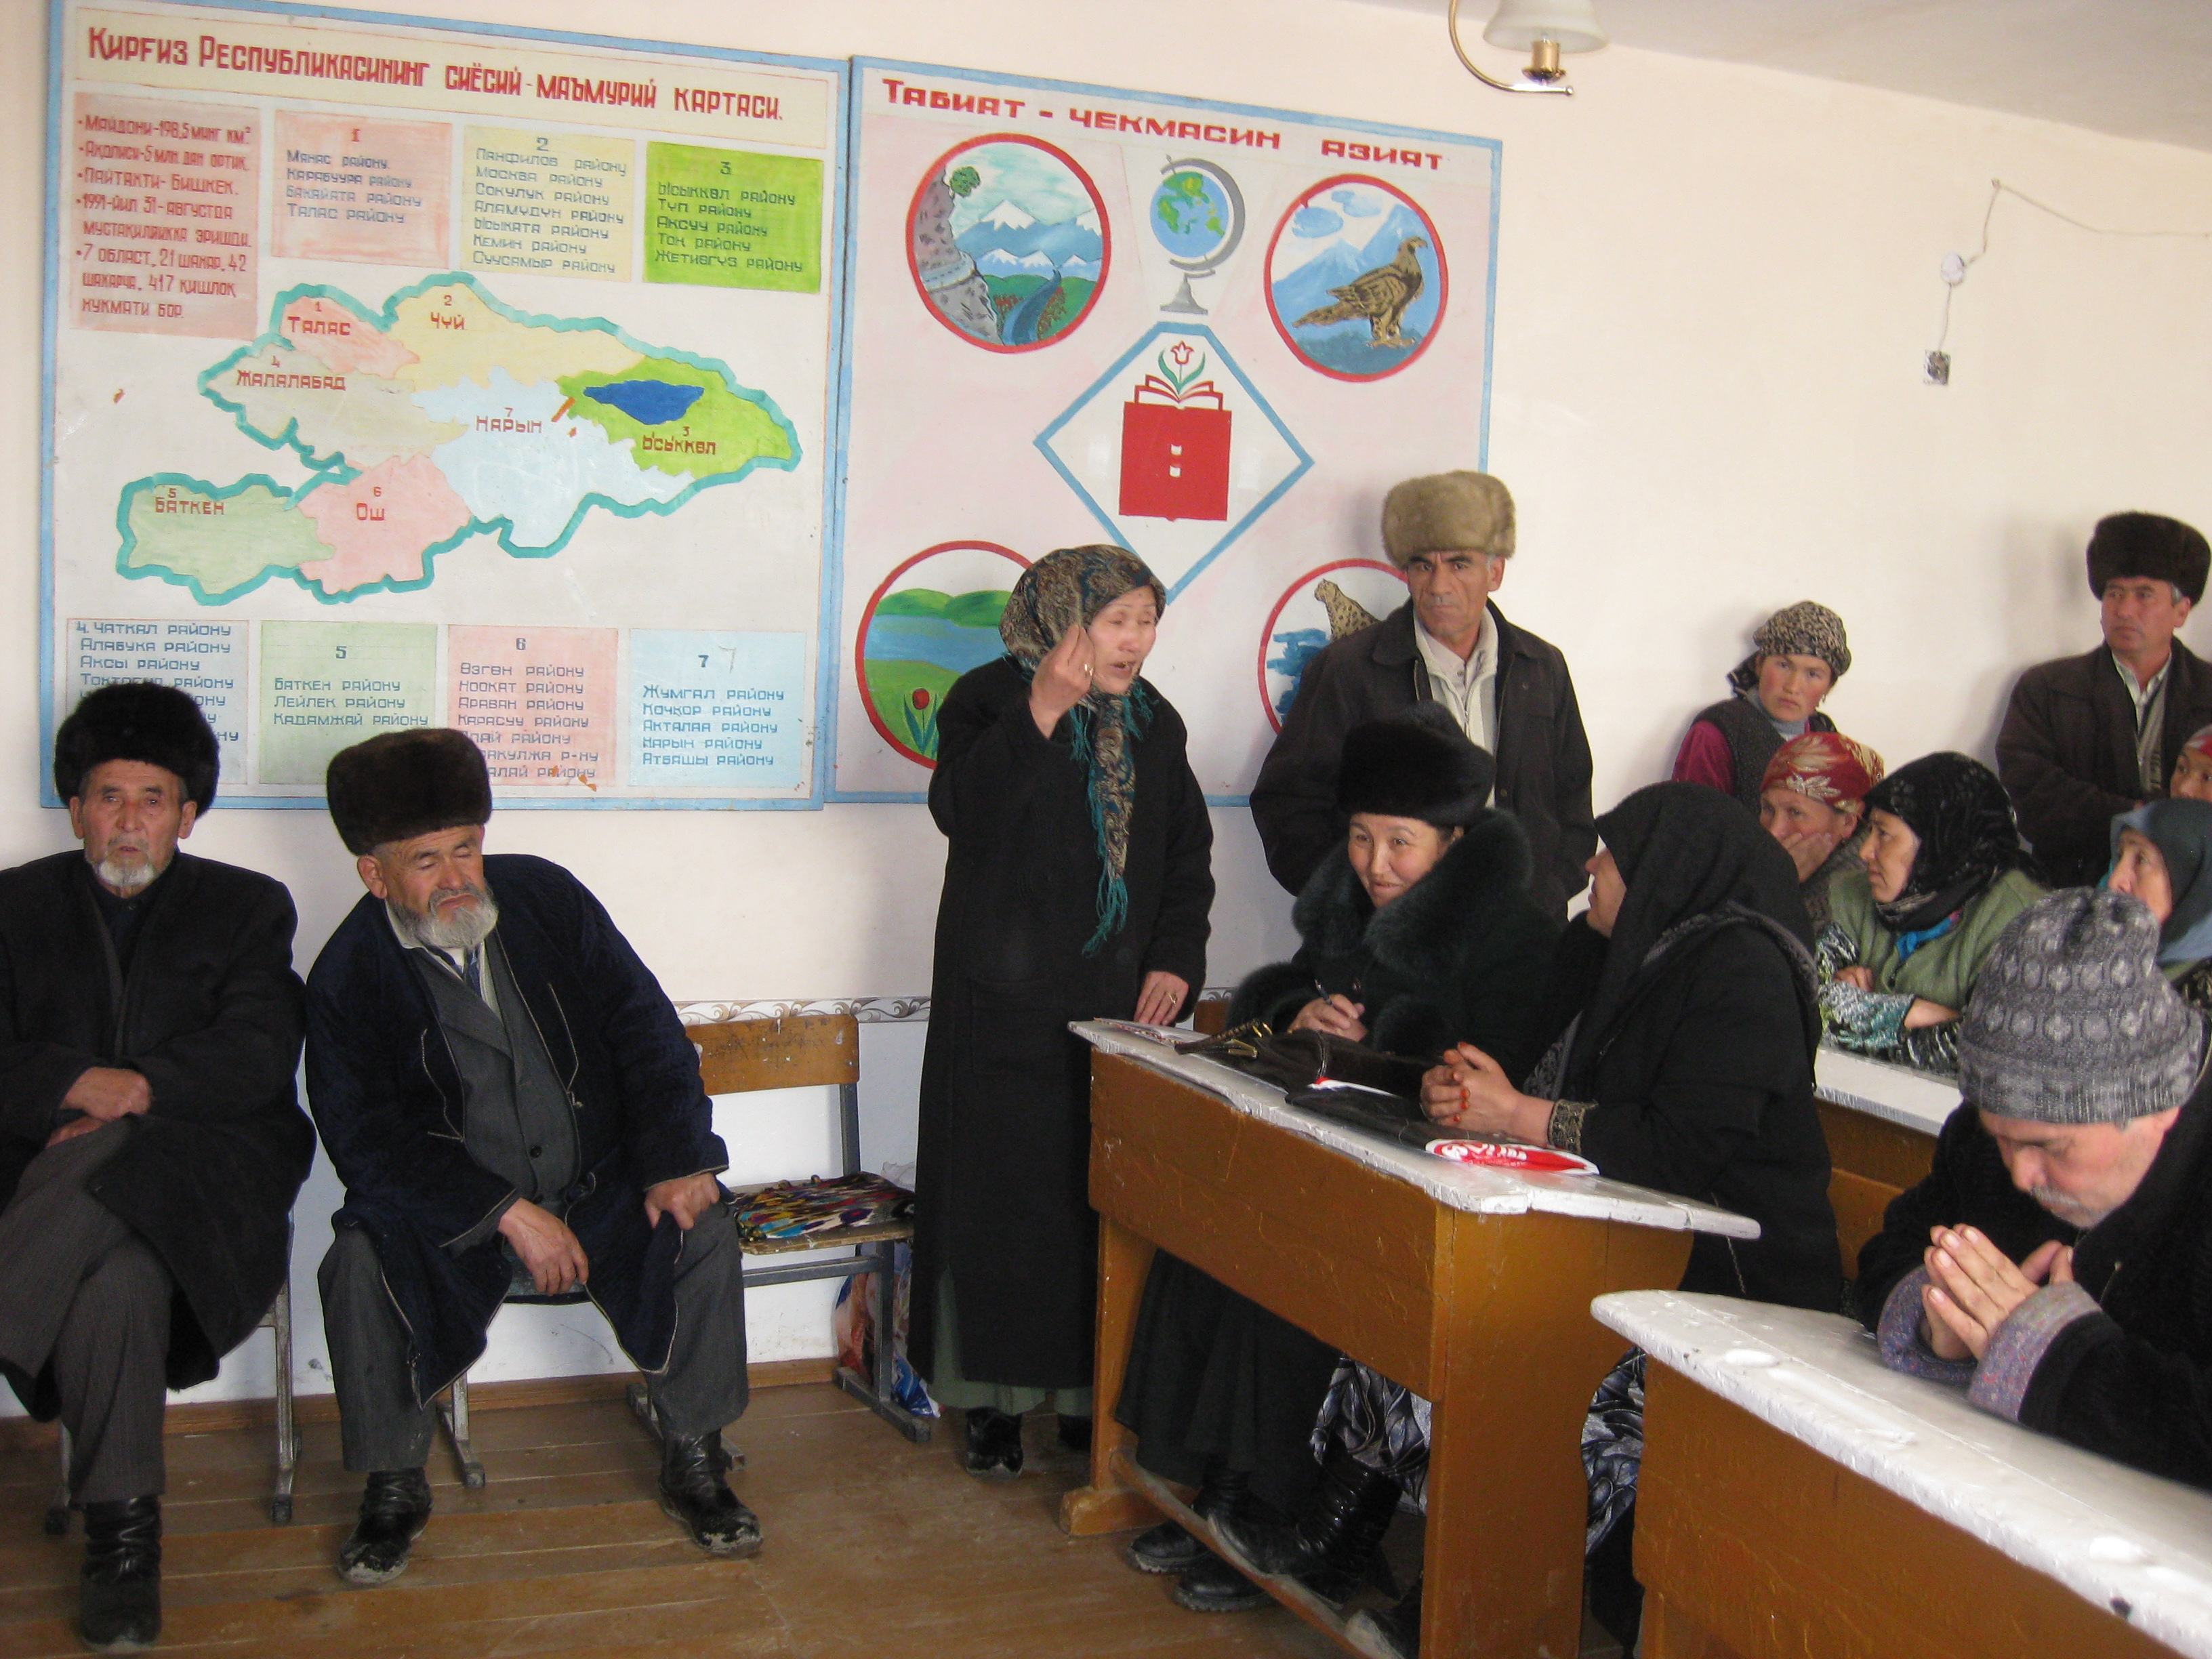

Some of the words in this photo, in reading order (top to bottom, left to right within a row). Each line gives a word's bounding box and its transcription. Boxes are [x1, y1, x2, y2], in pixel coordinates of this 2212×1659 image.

[537, 138, 549, 152] 2
[720, 161, 731, 175] 3
[85, 243, 93, 260] 7
[160, 248, 174, 266] 21
[228, 253, 245, 271] 42
[149, 274, 174, 292] 417
[444, 295, 452, 306] 2
[272, 355, 280, 367] 4
[505, 407, 513, 417] 7
[683, 426, 689, 436] 3
[168, 489, 176, 497] 5
[373, 487, 382, 497] 6
[516, 638, 527, 650] 6
[336, 646, 346, 659] 5
[698, 655, 709, 668] 7
